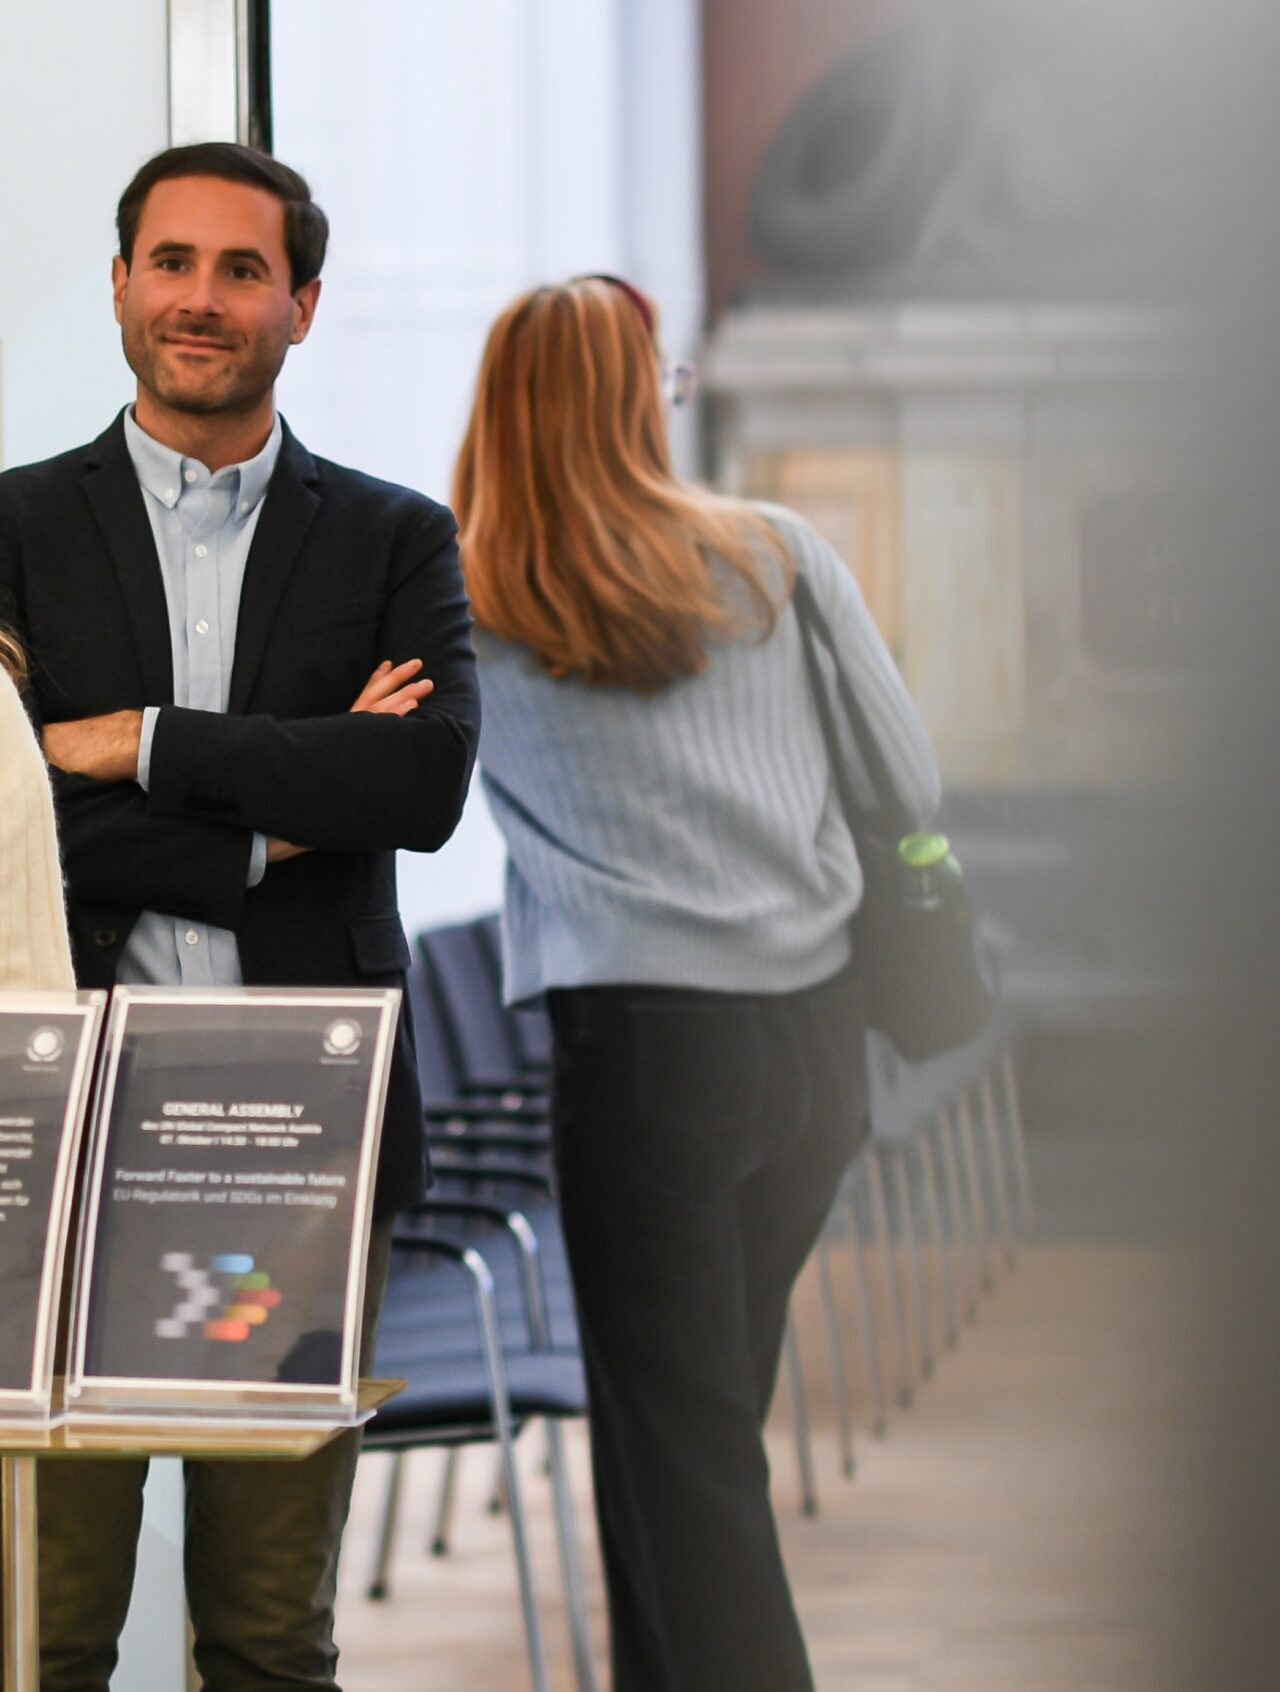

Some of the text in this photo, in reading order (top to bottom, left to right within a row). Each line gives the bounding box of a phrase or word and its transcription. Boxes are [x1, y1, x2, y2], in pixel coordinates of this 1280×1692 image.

[162, 1101, 304, 1118] GENERAL ASSEMBLY
[115, 1170, 346, 1187] Forward Faster to a sustainable future
[203, 1191, 226, 1203] und
[229, 1191, 263, 1204] SDGs
[266, 1192, 282, 1204] im
[283, 1192, 338, 1208] Einklang
